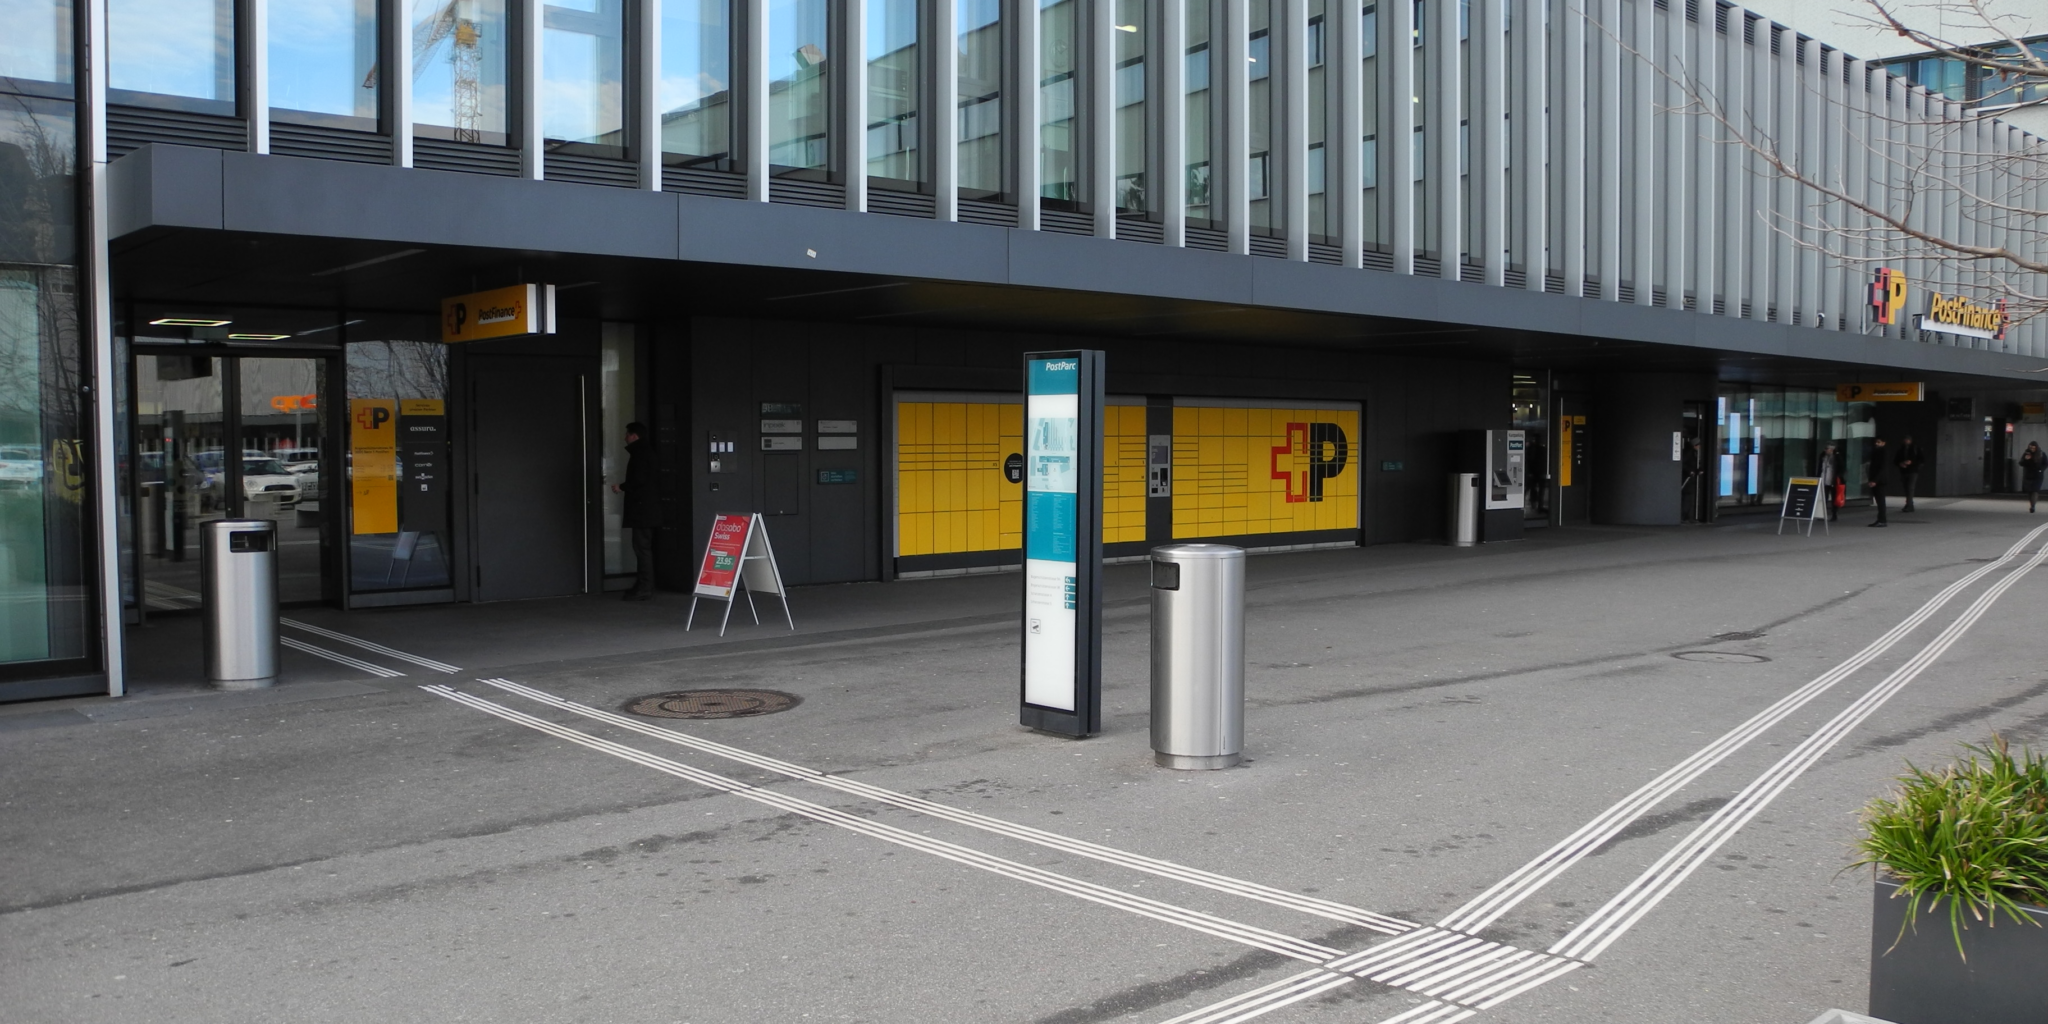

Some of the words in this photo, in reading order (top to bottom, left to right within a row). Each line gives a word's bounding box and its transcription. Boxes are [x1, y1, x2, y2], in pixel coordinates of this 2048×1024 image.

[478, 306, 515, 321] PostFinance
[1929, 292, 2000, 331] PostFinance
[1045, 361, 1076, 371] PostParc
[714, 532, 730, 540] Swiss
